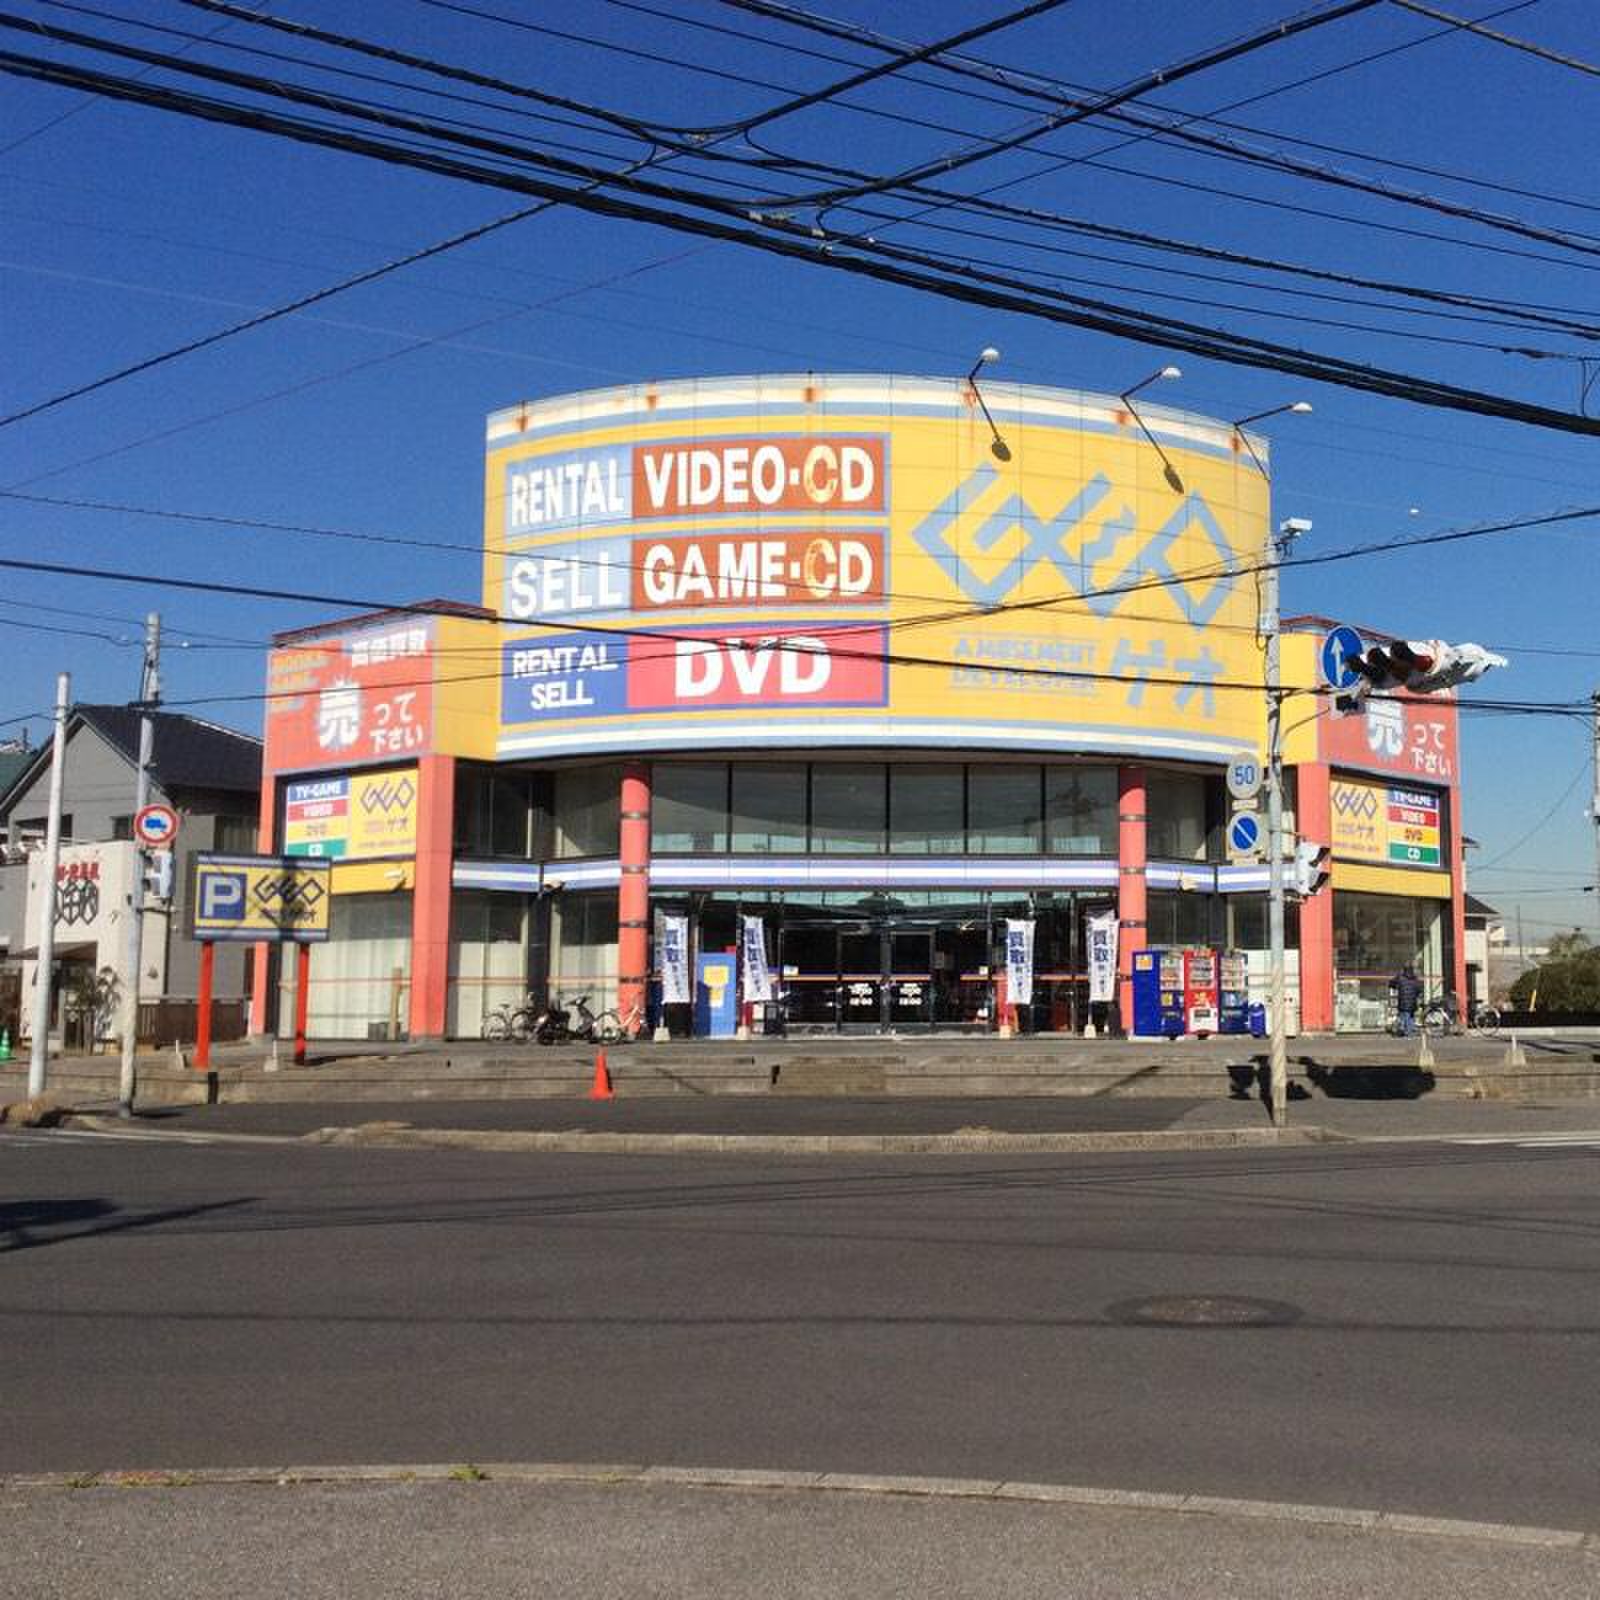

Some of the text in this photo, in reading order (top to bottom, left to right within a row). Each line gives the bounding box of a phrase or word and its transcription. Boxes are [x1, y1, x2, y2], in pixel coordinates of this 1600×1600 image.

[511, 458, 625, 526] RENTAL
[511, 551, 623, 618] SELL
[513, 644, 618, 678] RENTAL
[674, 637, 831, 697] DVD
[530, 680, 594, 710] SELL
[1109, 640, 1224, 718] ゲオ
[317, 675, 361, 751] 売
[373, 691, 416, 726] って
[370, 724, 424, 753] 下さい
[1412, 722, 1446, 750] って
[1235, 765, 1254, 785] 50
[1410, 747, 1452, 776] 下さい
[204, 875, 241, 917] P
